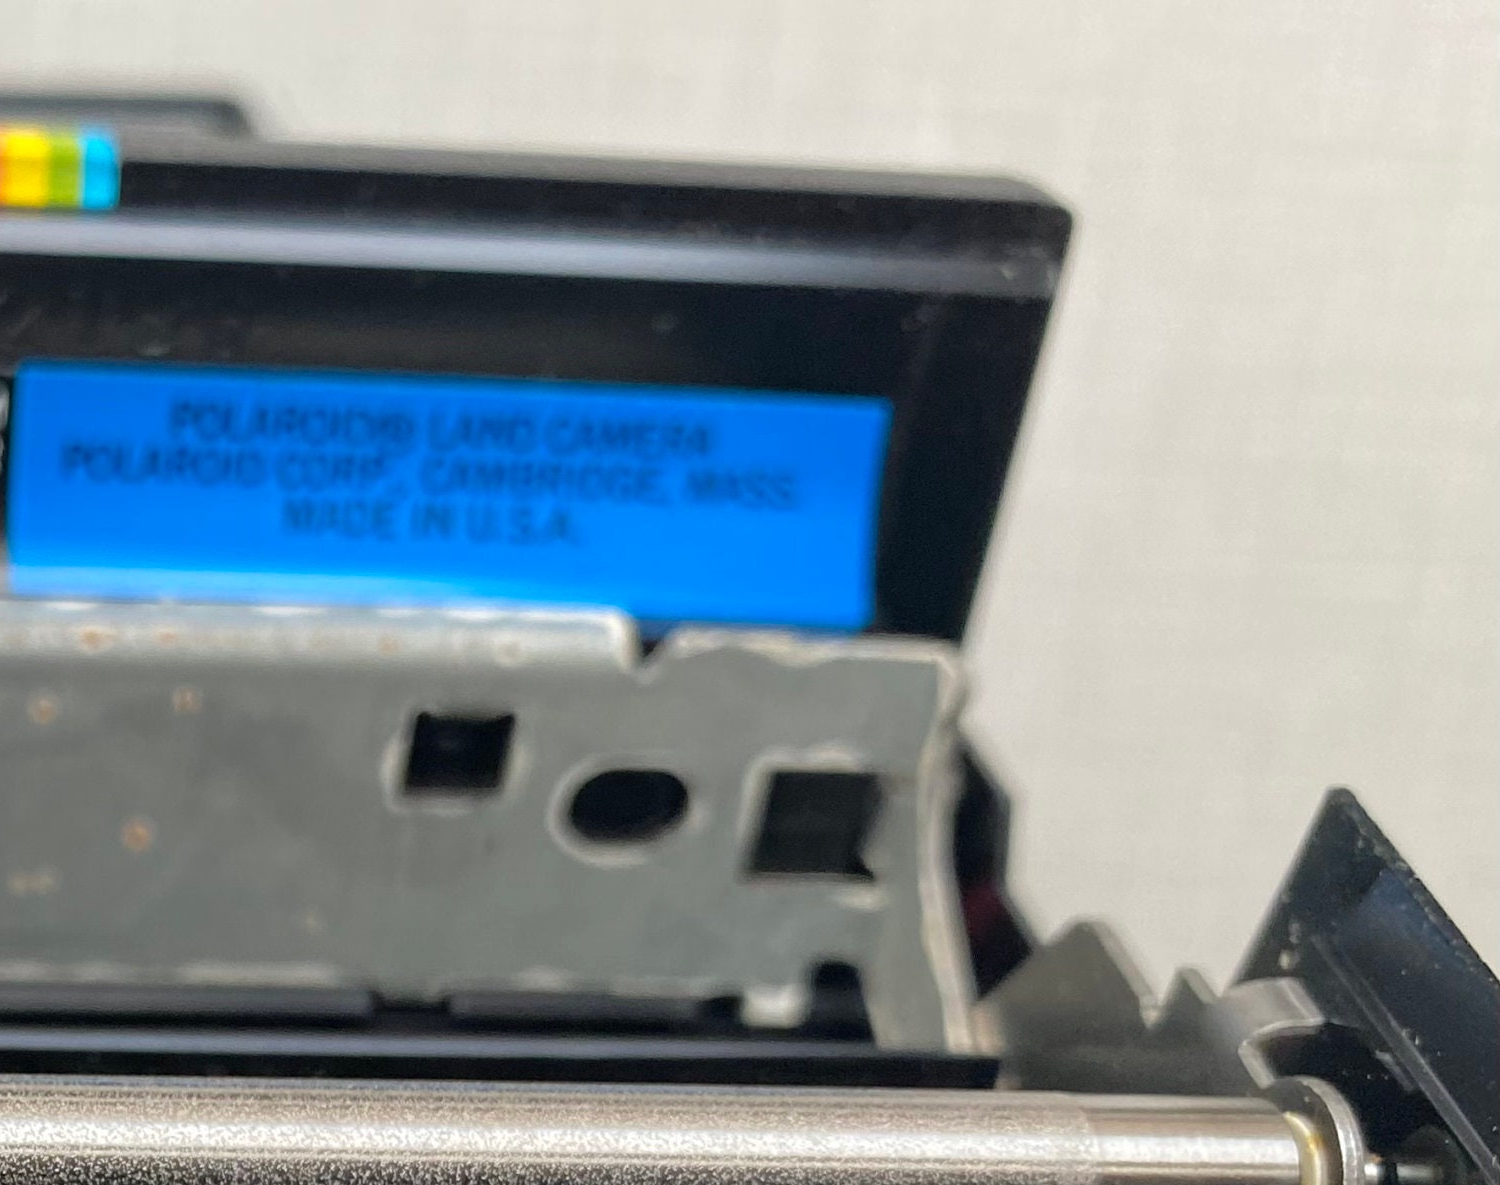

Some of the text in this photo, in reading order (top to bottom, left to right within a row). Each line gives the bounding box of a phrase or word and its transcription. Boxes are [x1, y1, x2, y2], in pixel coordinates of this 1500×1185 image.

[427, 405, 532, 454] LAND
[542, 412, 713, 460] CAMERA
[60, 440, 270, 488] POLAROID
[283, 496, 396, 542] MADE
[411, 501, 454, 543] IN
